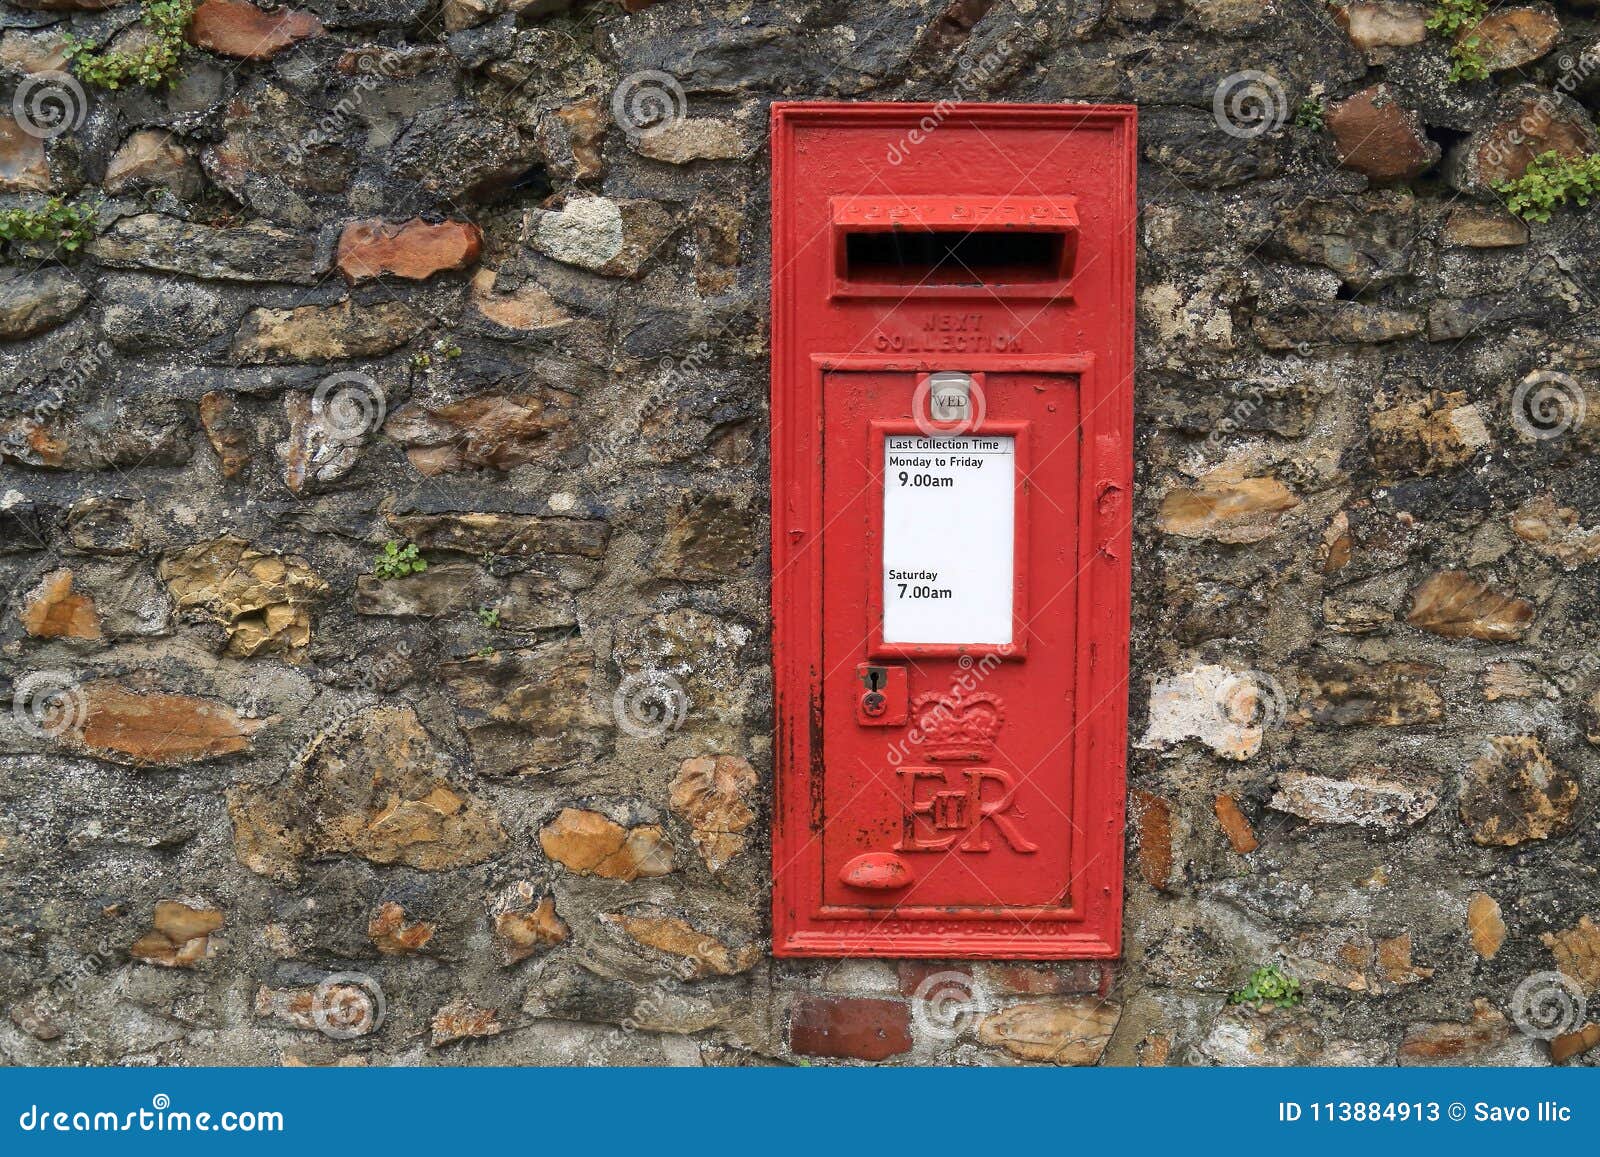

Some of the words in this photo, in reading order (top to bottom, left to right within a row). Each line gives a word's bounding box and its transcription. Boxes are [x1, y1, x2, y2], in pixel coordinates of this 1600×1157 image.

[921, 312, 984, 332] NEXT
[874, 335, 1025, 353] COLLECTION
[932, 394, 968, 408] WED
[889, 439, 913, 450] Last
[916, 439, 969, 450] Collection
[971, 440, 999, 450] Time
[889, 456, 931, 468] Monday
[935, 457, 946, 467] to
[950, 456, 984, 468] Friday
[898, 471, 953, 487] 9.00am
[888, 569, 938, 581] Saturday
[897, 583, 952, 599] 7.00am
